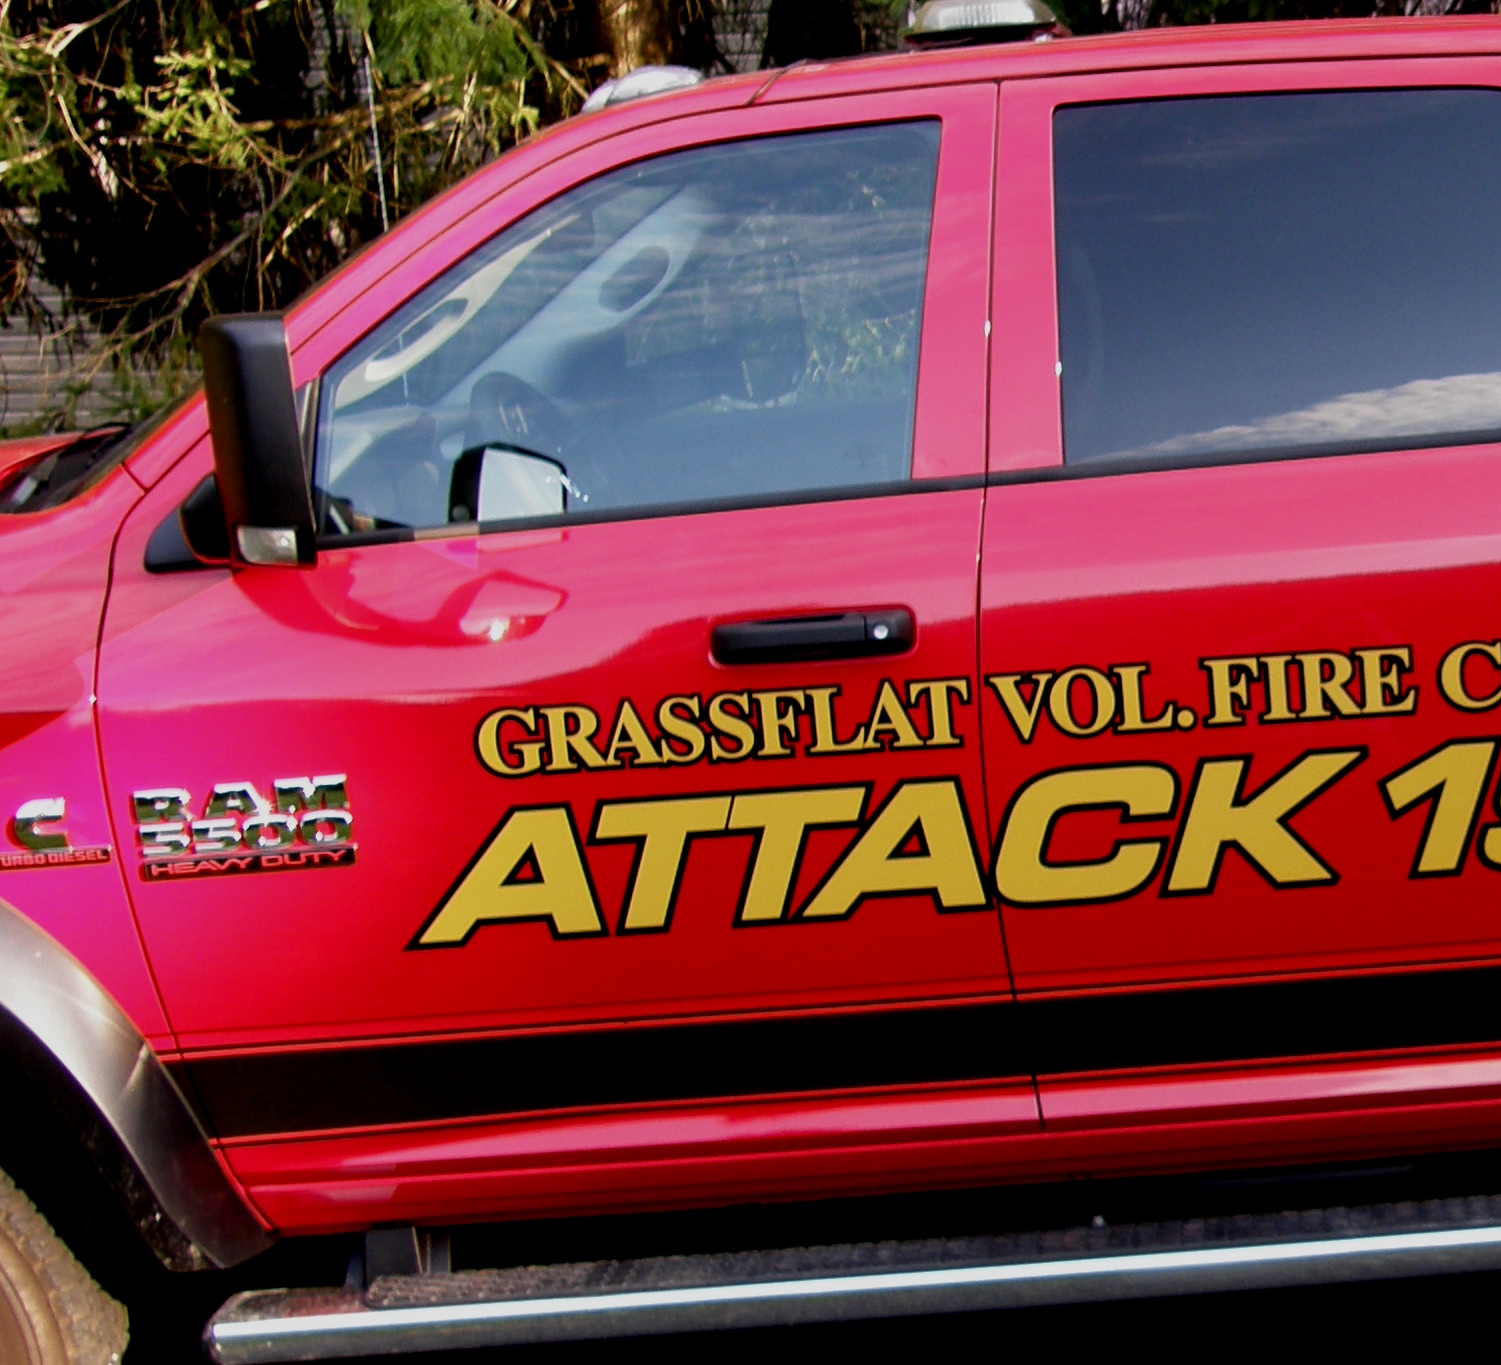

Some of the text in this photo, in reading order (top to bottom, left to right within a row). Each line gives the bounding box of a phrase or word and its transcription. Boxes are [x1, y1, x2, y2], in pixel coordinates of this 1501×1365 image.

[473, 679, 971, 779] GRASSFLAT
[985, 660, 1197, 744] VOL.
[1199, 645, 1421, 729] FIRE
[133, 773, 347, 822] RAM
[139, 809, 353, 857] 5500
[404, 746, 1369, 951] ATTACK
[0, 849, 106, 867] URBO DIESEL
[151, 849, 347, 876] HEAVY DUTY
